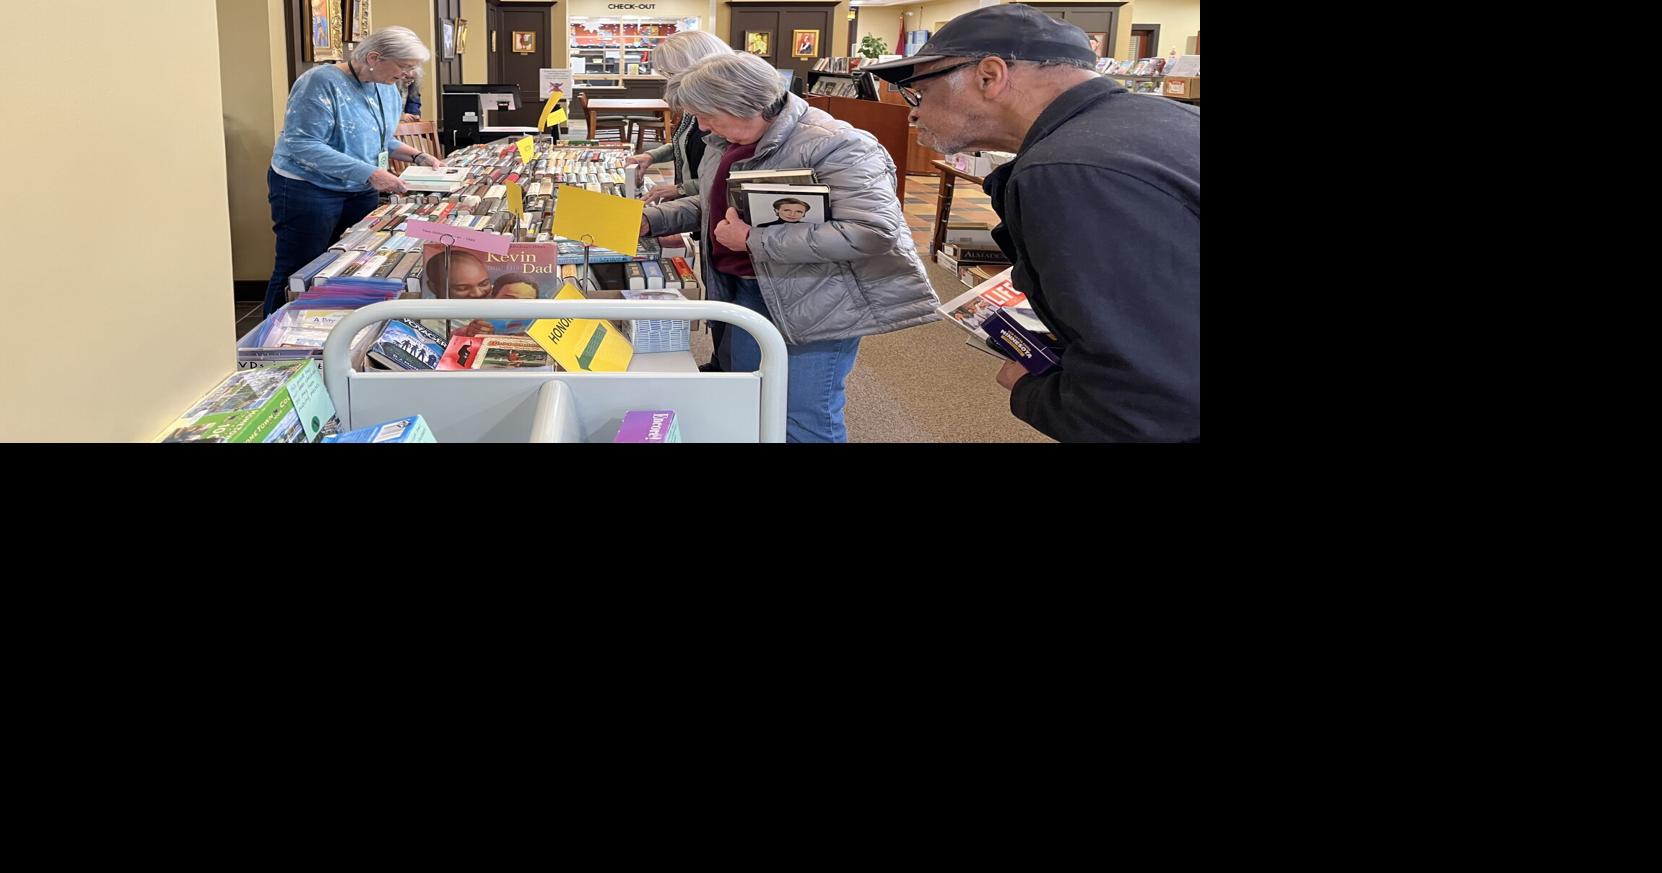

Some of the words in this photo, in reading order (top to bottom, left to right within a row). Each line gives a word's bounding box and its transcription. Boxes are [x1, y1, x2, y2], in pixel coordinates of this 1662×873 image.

[486, 251, 536, 263] Kevin
[522, 263, 553, 274] Dad
[999, 329, 1033, 359] MINNESOTA
